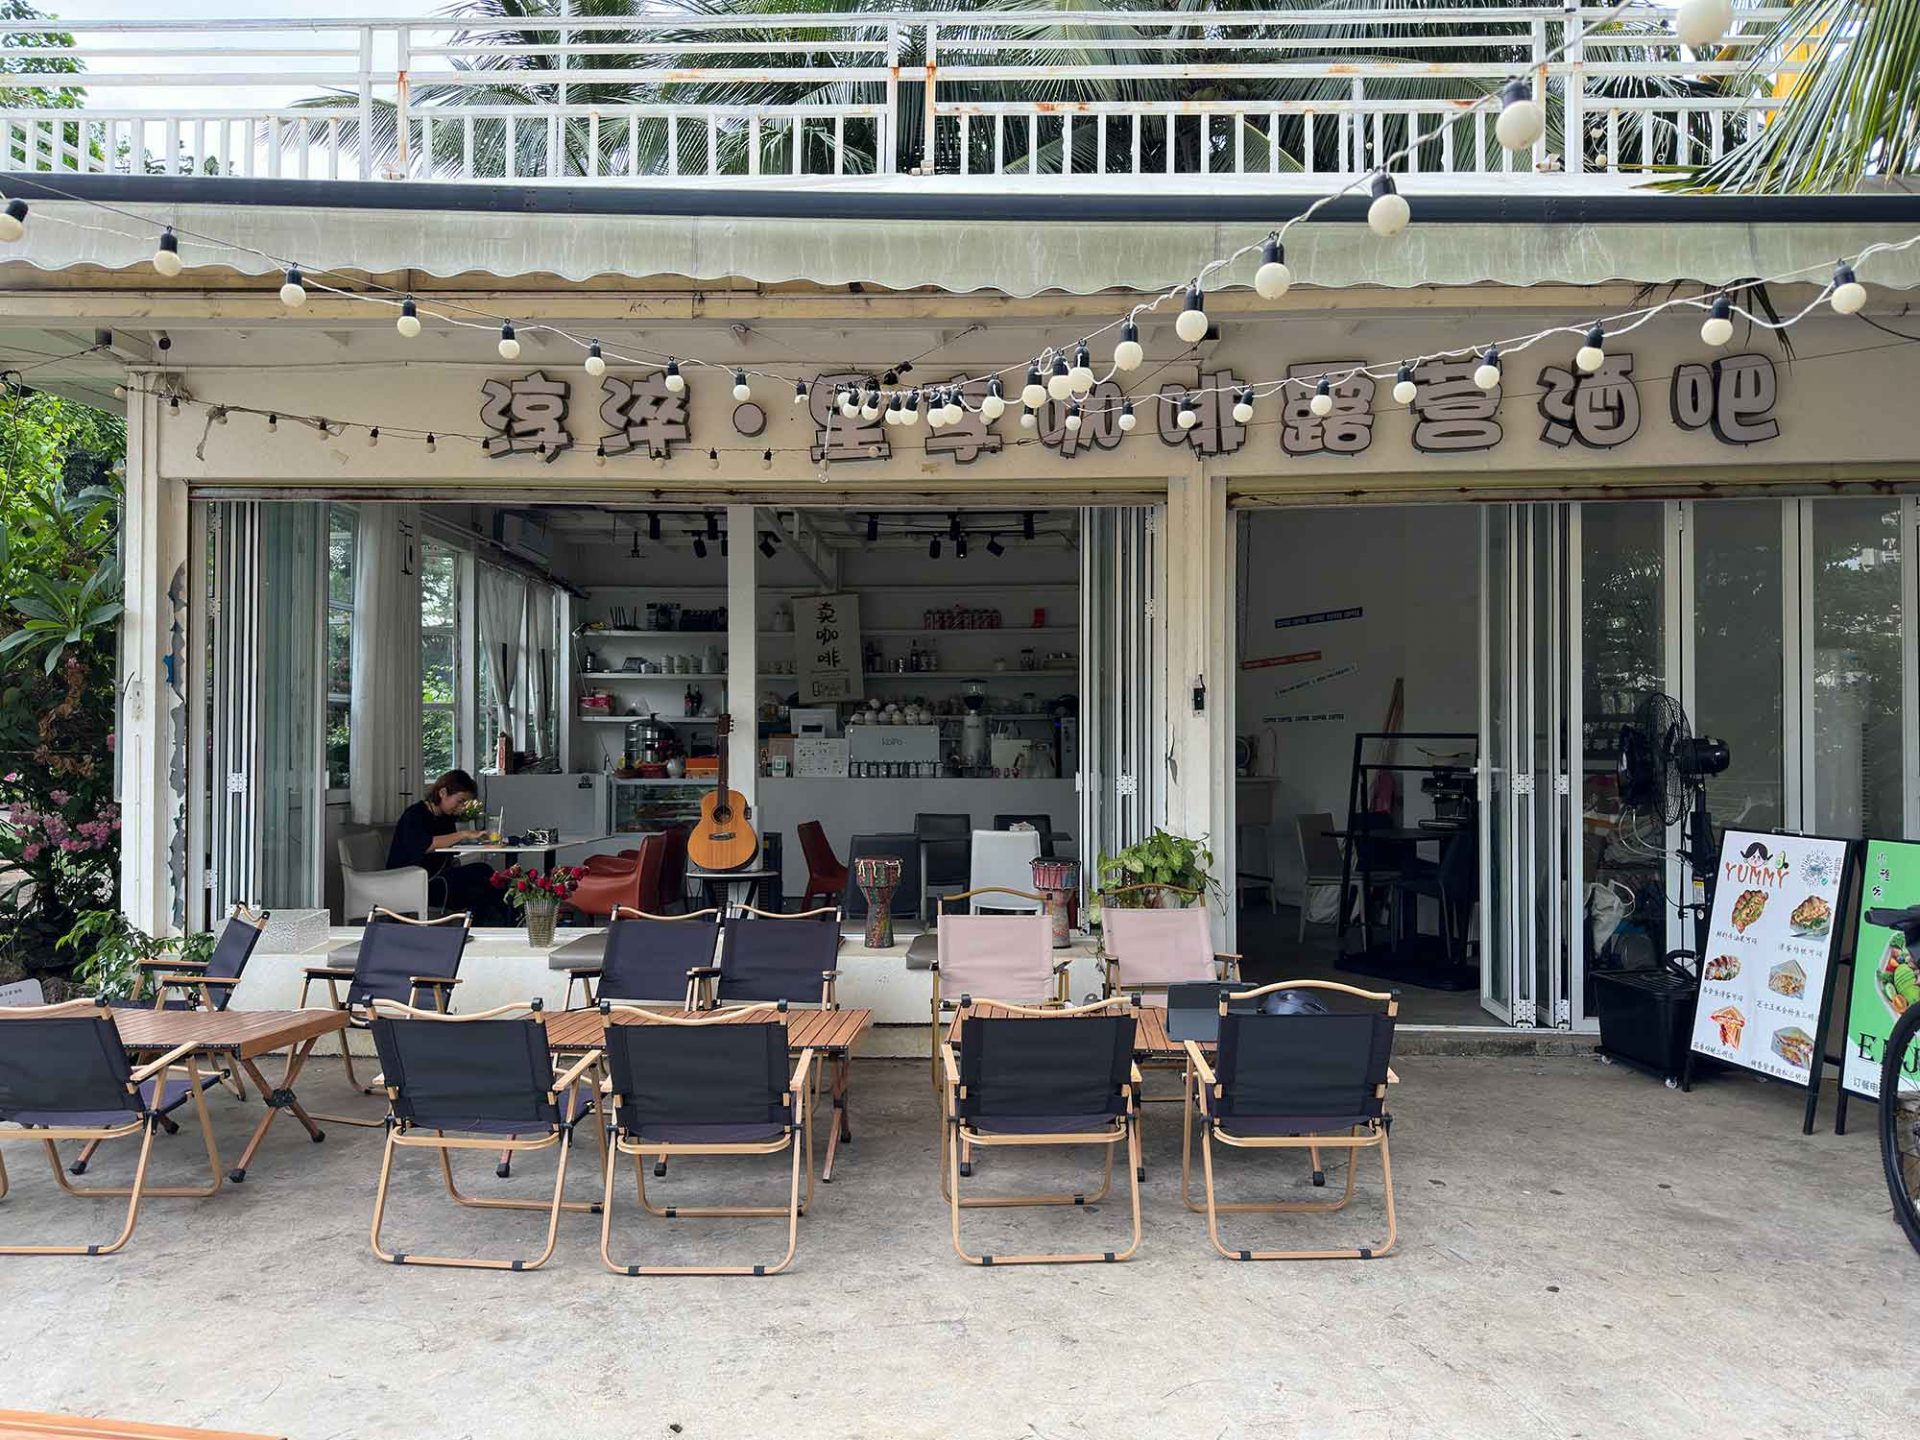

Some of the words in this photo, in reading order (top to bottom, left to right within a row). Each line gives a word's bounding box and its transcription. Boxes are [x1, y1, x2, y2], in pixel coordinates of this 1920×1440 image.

[816, 602, 840, 668] 卖咖啡
[1725, 861, 1790, 889] YUMMY
